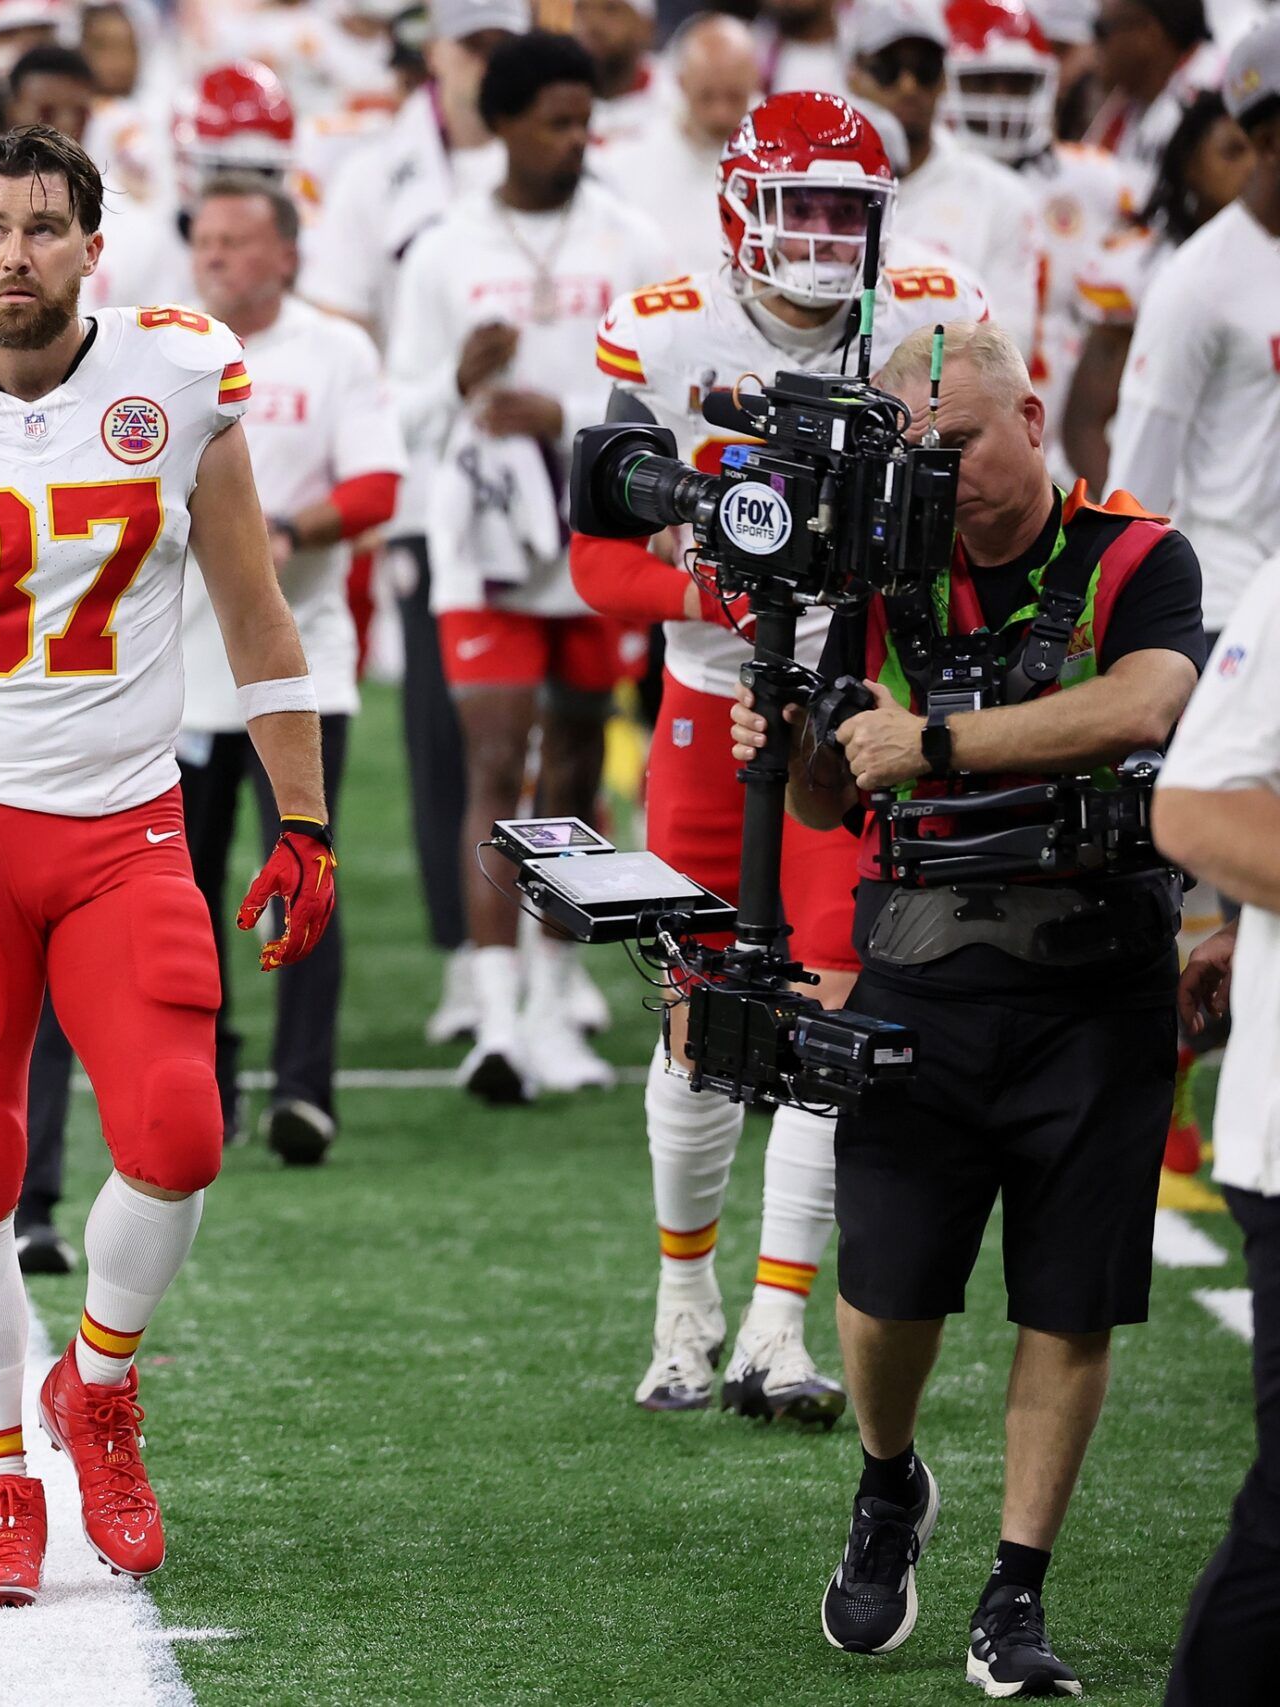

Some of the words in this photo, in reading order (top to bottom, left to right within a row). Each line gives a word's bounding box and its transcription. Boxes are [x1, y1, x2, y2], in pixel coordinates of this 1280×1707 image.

[136, 305, 213, 335] 8
[26, 424, 45, 435] NFL
[111, 405, 159, 438] A
[725, 469, 749, 480] SONY
[736, 496, 775, 529] FOX
[736, 523, 775, 540] SPORTS
[901, 804, 935, 818] PRO
